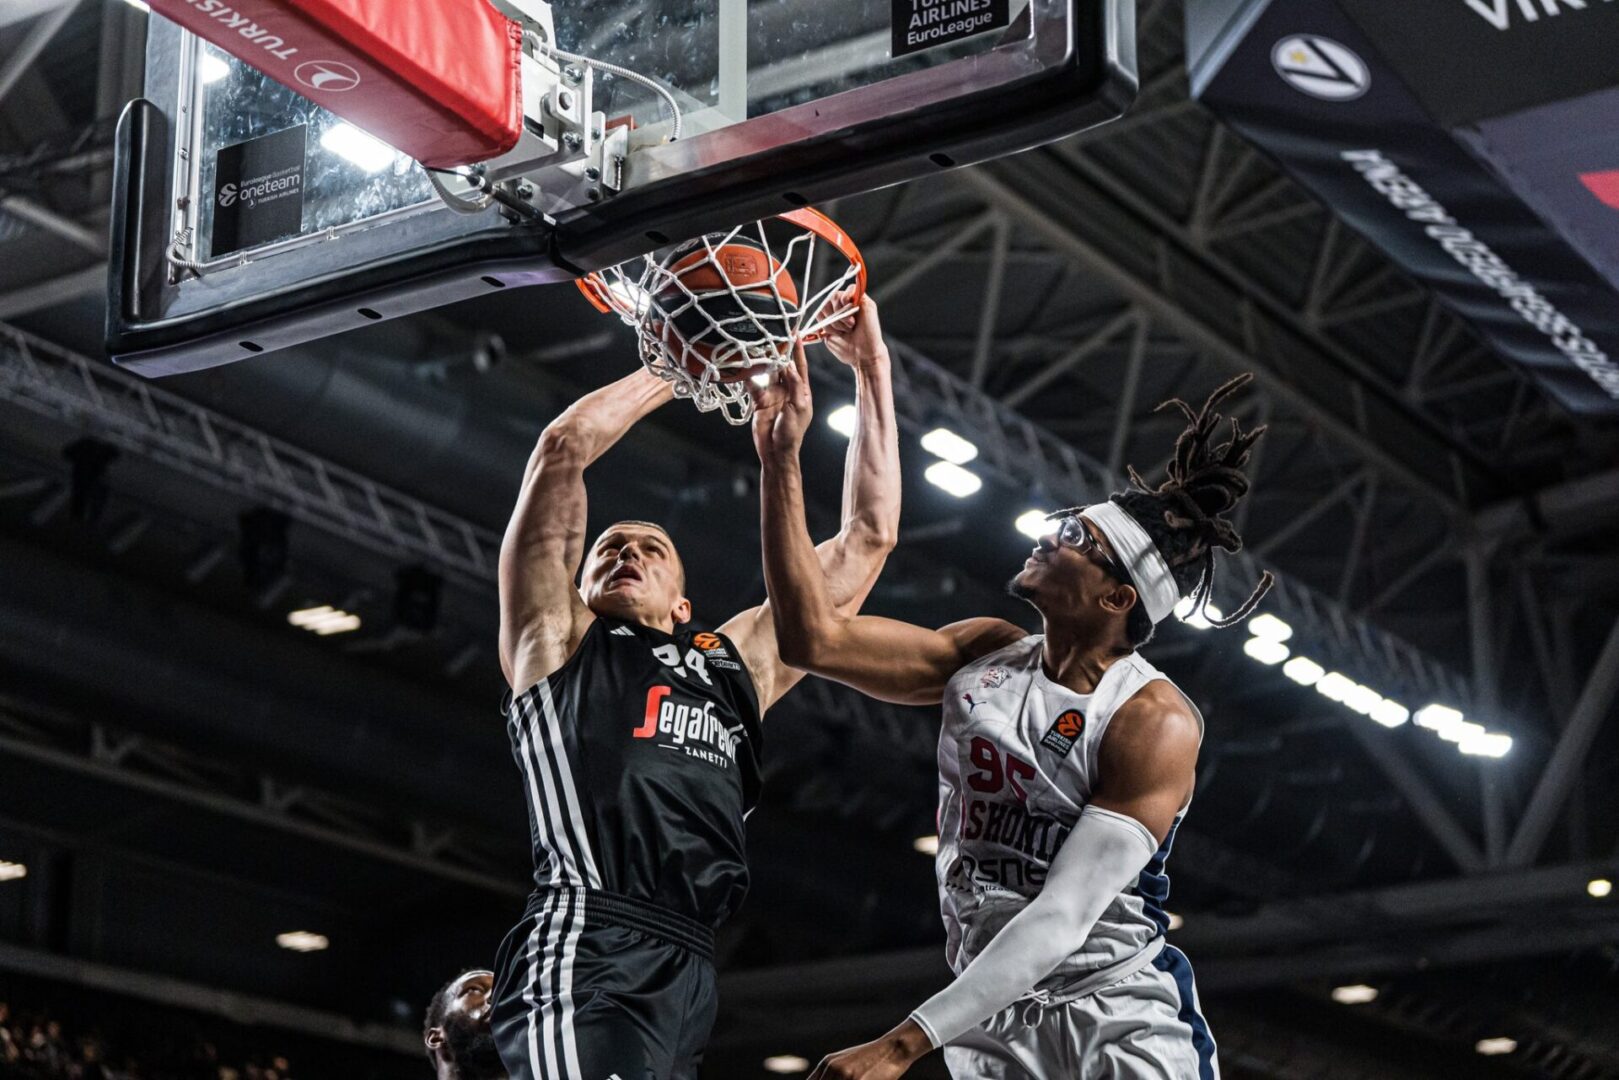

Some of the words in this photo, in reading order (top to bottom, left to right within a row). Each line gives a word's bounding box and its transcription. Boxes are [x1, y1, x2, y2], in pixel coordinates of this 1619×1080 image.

[907, 12, 993, 46] EuroLeague
[909, 0, 991, 29] AIRLINES
[186, 0, 299, 60] TURKIS
[240, 174, 301, 201] oneteam
[684, 746, 727, 769] ZANETTI
